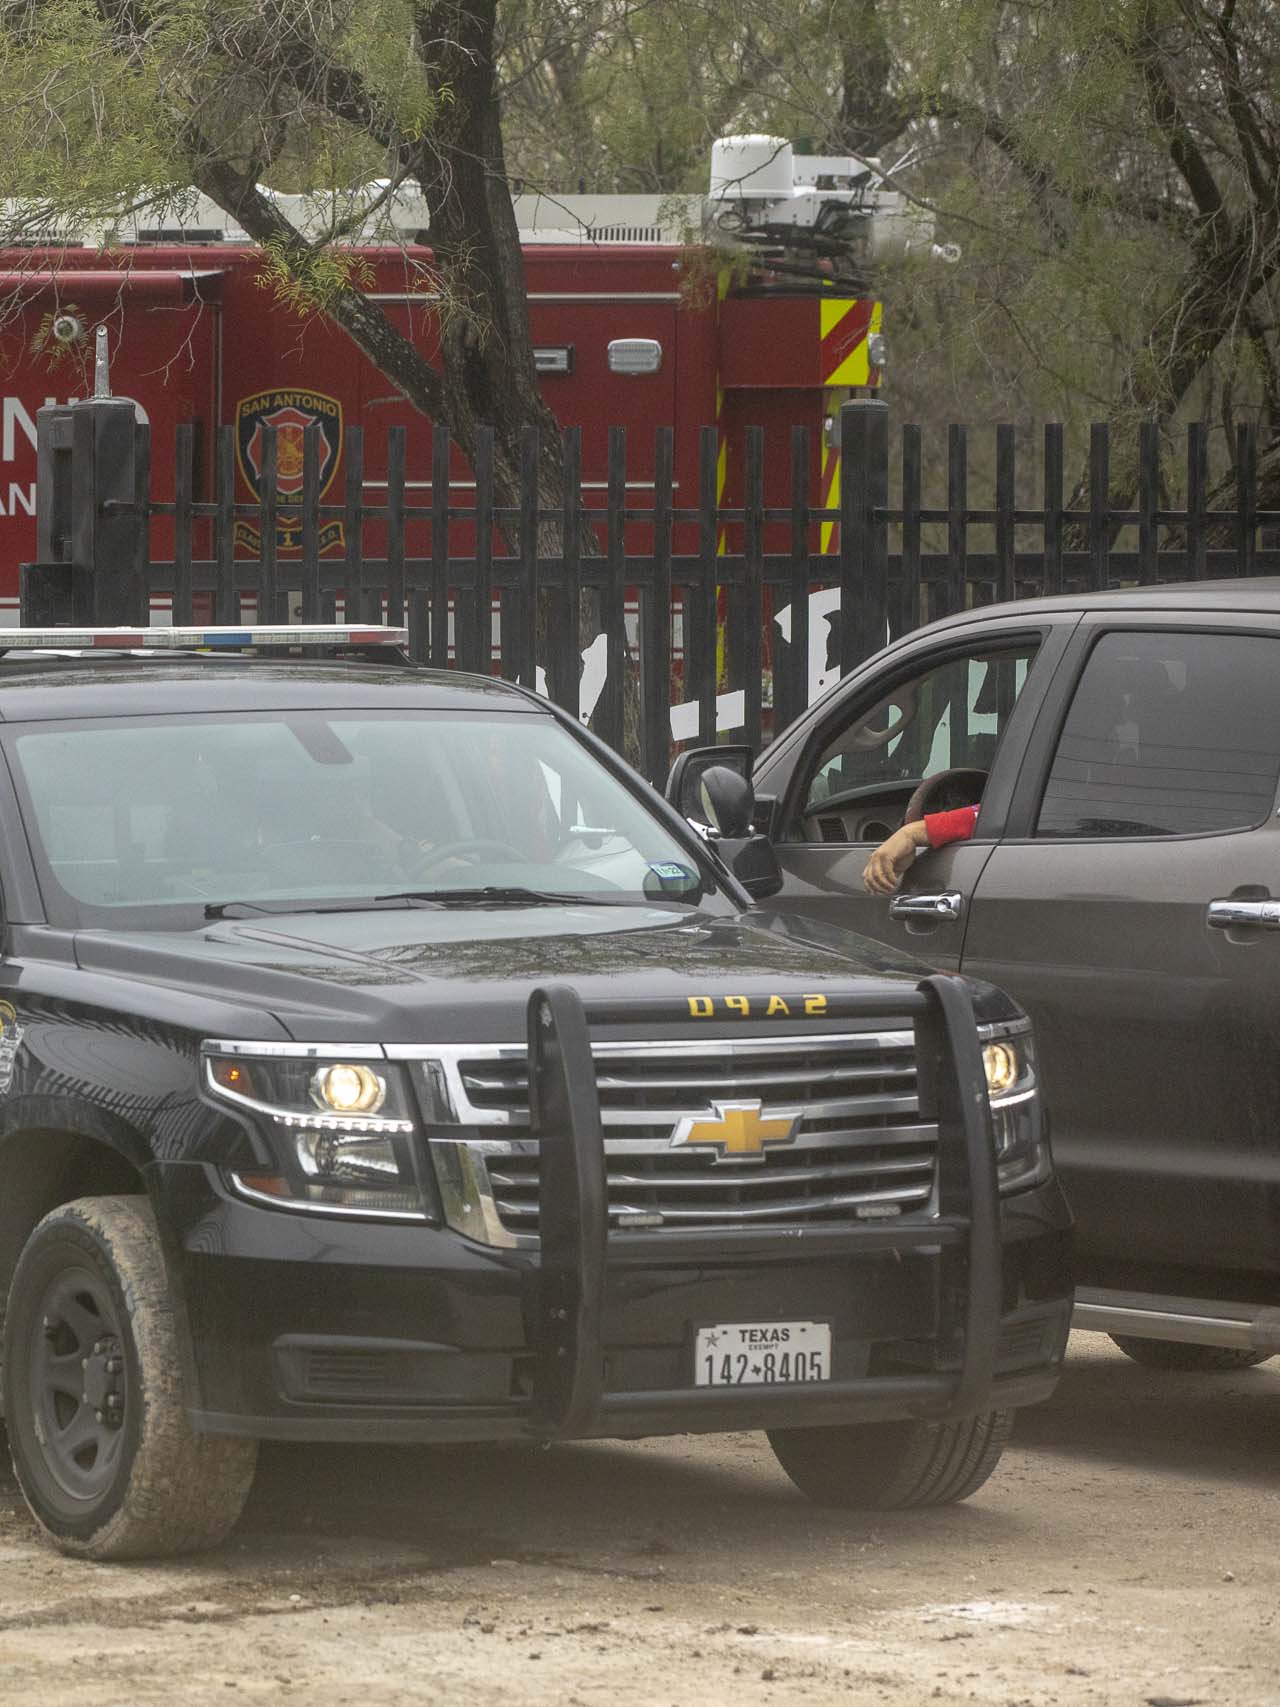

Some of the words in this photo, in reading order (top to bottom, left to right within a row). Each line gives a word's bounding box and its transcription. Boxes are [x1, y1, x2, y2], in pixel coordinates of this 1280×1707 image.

[241, 396, 270, 416] SAN
[273, 393, 337, 417] ANTONIO
[738, 1328, 790, 1343] TEXAS
[748, 1343, 780, 1351] EXEMPT
